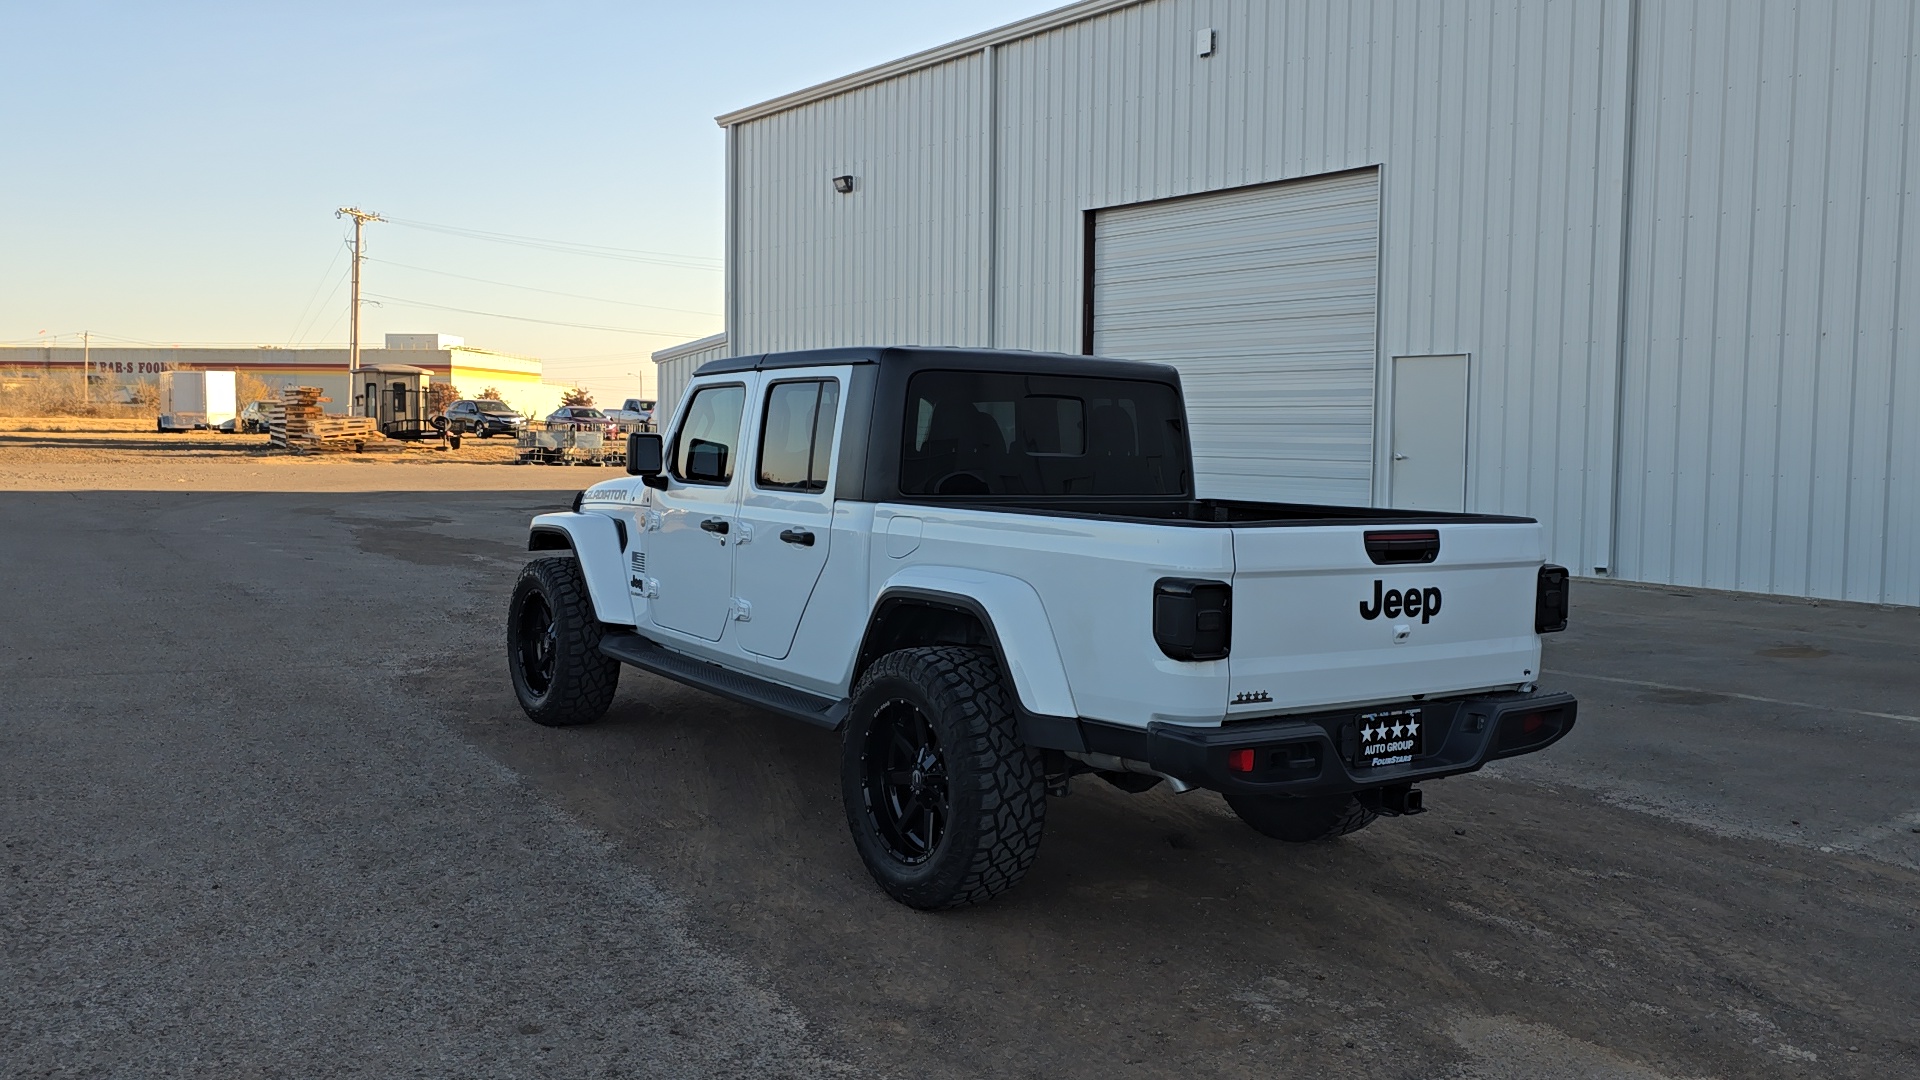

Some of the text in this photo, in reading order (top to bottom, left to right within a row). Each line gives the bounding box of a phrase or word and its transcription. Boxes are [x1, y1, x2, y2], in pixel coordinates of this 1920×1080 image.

[1359, 579, 1442, 624] Jeep
[1364, 739, 1414, 756] AUTO GROUP
